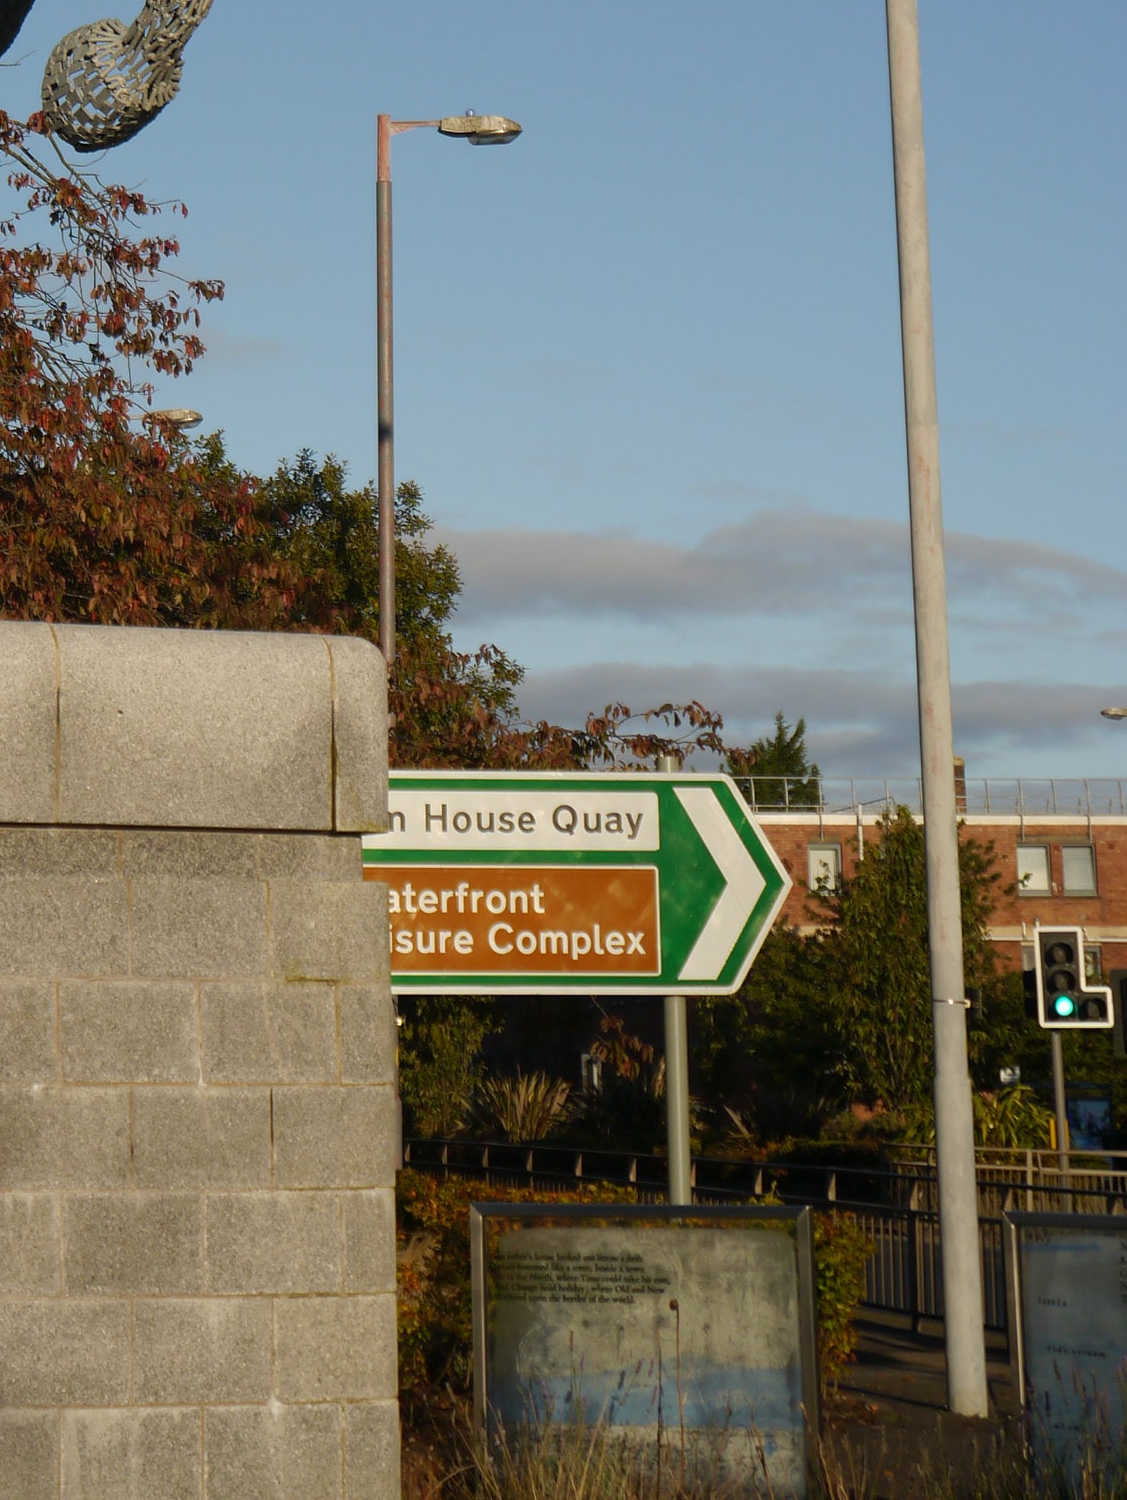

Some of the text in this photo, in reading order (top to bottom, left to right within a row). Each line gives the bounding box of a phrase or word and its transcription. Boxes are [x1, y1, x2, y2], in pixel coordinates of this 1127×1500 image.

[424, 803, 536, 834] House
[551, 804, 644, 839] Quay
[388, 882, 546, 915] aterfront
[388, 923, 646, 960] isure Complex
